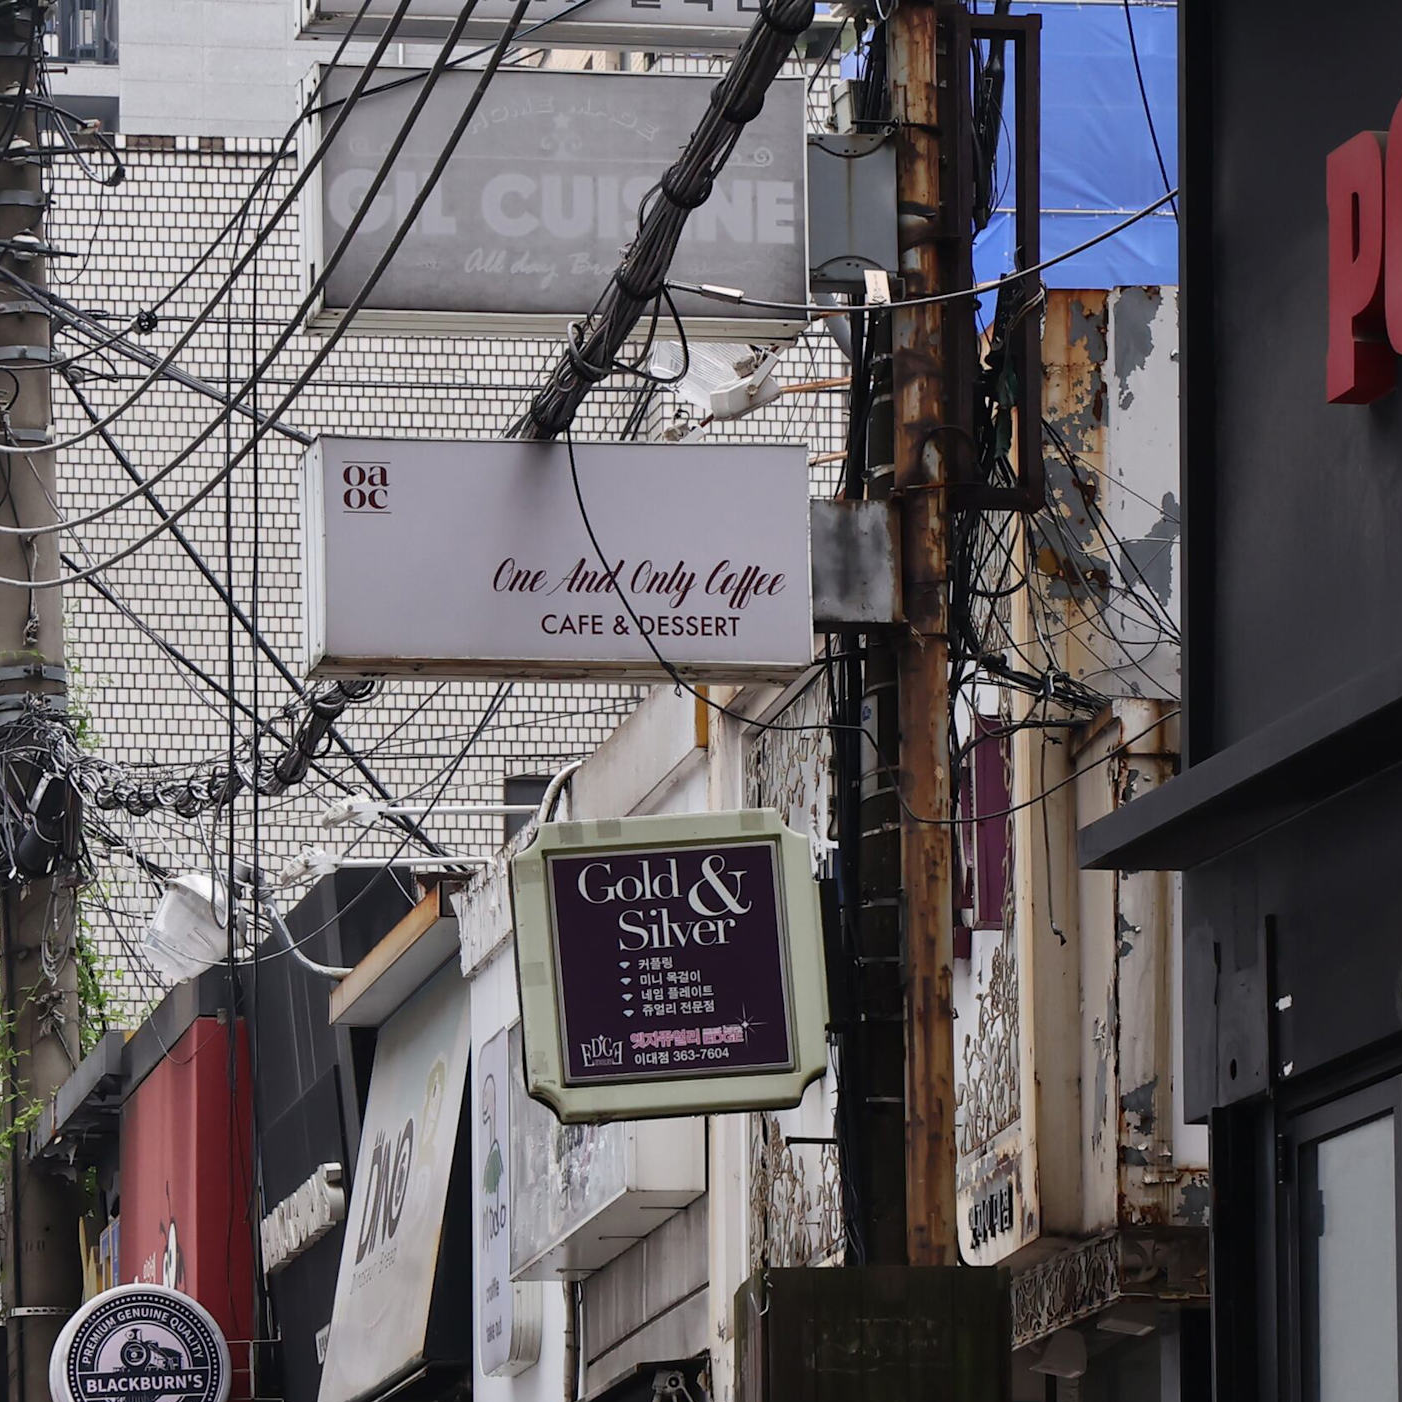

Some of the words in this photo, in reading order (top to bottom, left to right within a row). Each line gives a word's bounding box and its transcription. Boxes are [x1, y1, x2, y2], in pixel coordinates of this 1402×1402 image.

[327, 168, 457, 238] GIL
[493, 557, 548, 593] One
[558, 559, 624, 596] And
[631, 560, 698, 608] Only
[704, 558, 787, 610] Coffee
[541, 613, 604, 636] CAFE
[612, 614, 630, 636] &
[639, 614, 741, 637] DESSERT
[577, 858, 684, 904] Gold
[688, 854, 752, 917] &
[618, 909, 737, 951] Silver
[638, 956, 674, 971] 커플링
[639, 973, 664, 986] 미니
[666, 970, 702, 985] 목걸이
[641, 988, 665, 1001] 네임
[667, 985, 715, 1000] 플레이트
[642, 1002, 678, 1018] 쥬얼리
[680, 1000, 716, 1015] 전문점
[634, 1052, 670, 1066] 이대점
[673, 1047, 730, 1062] 363-7604
[81, 1316, 117, 1365] PREMIUM
[117, 1307, 170, 1323] GENUINE
[169, 1317, 204, 1359] QUALITY
[86, 1374, 204, 1394] BLACKBURN'S
